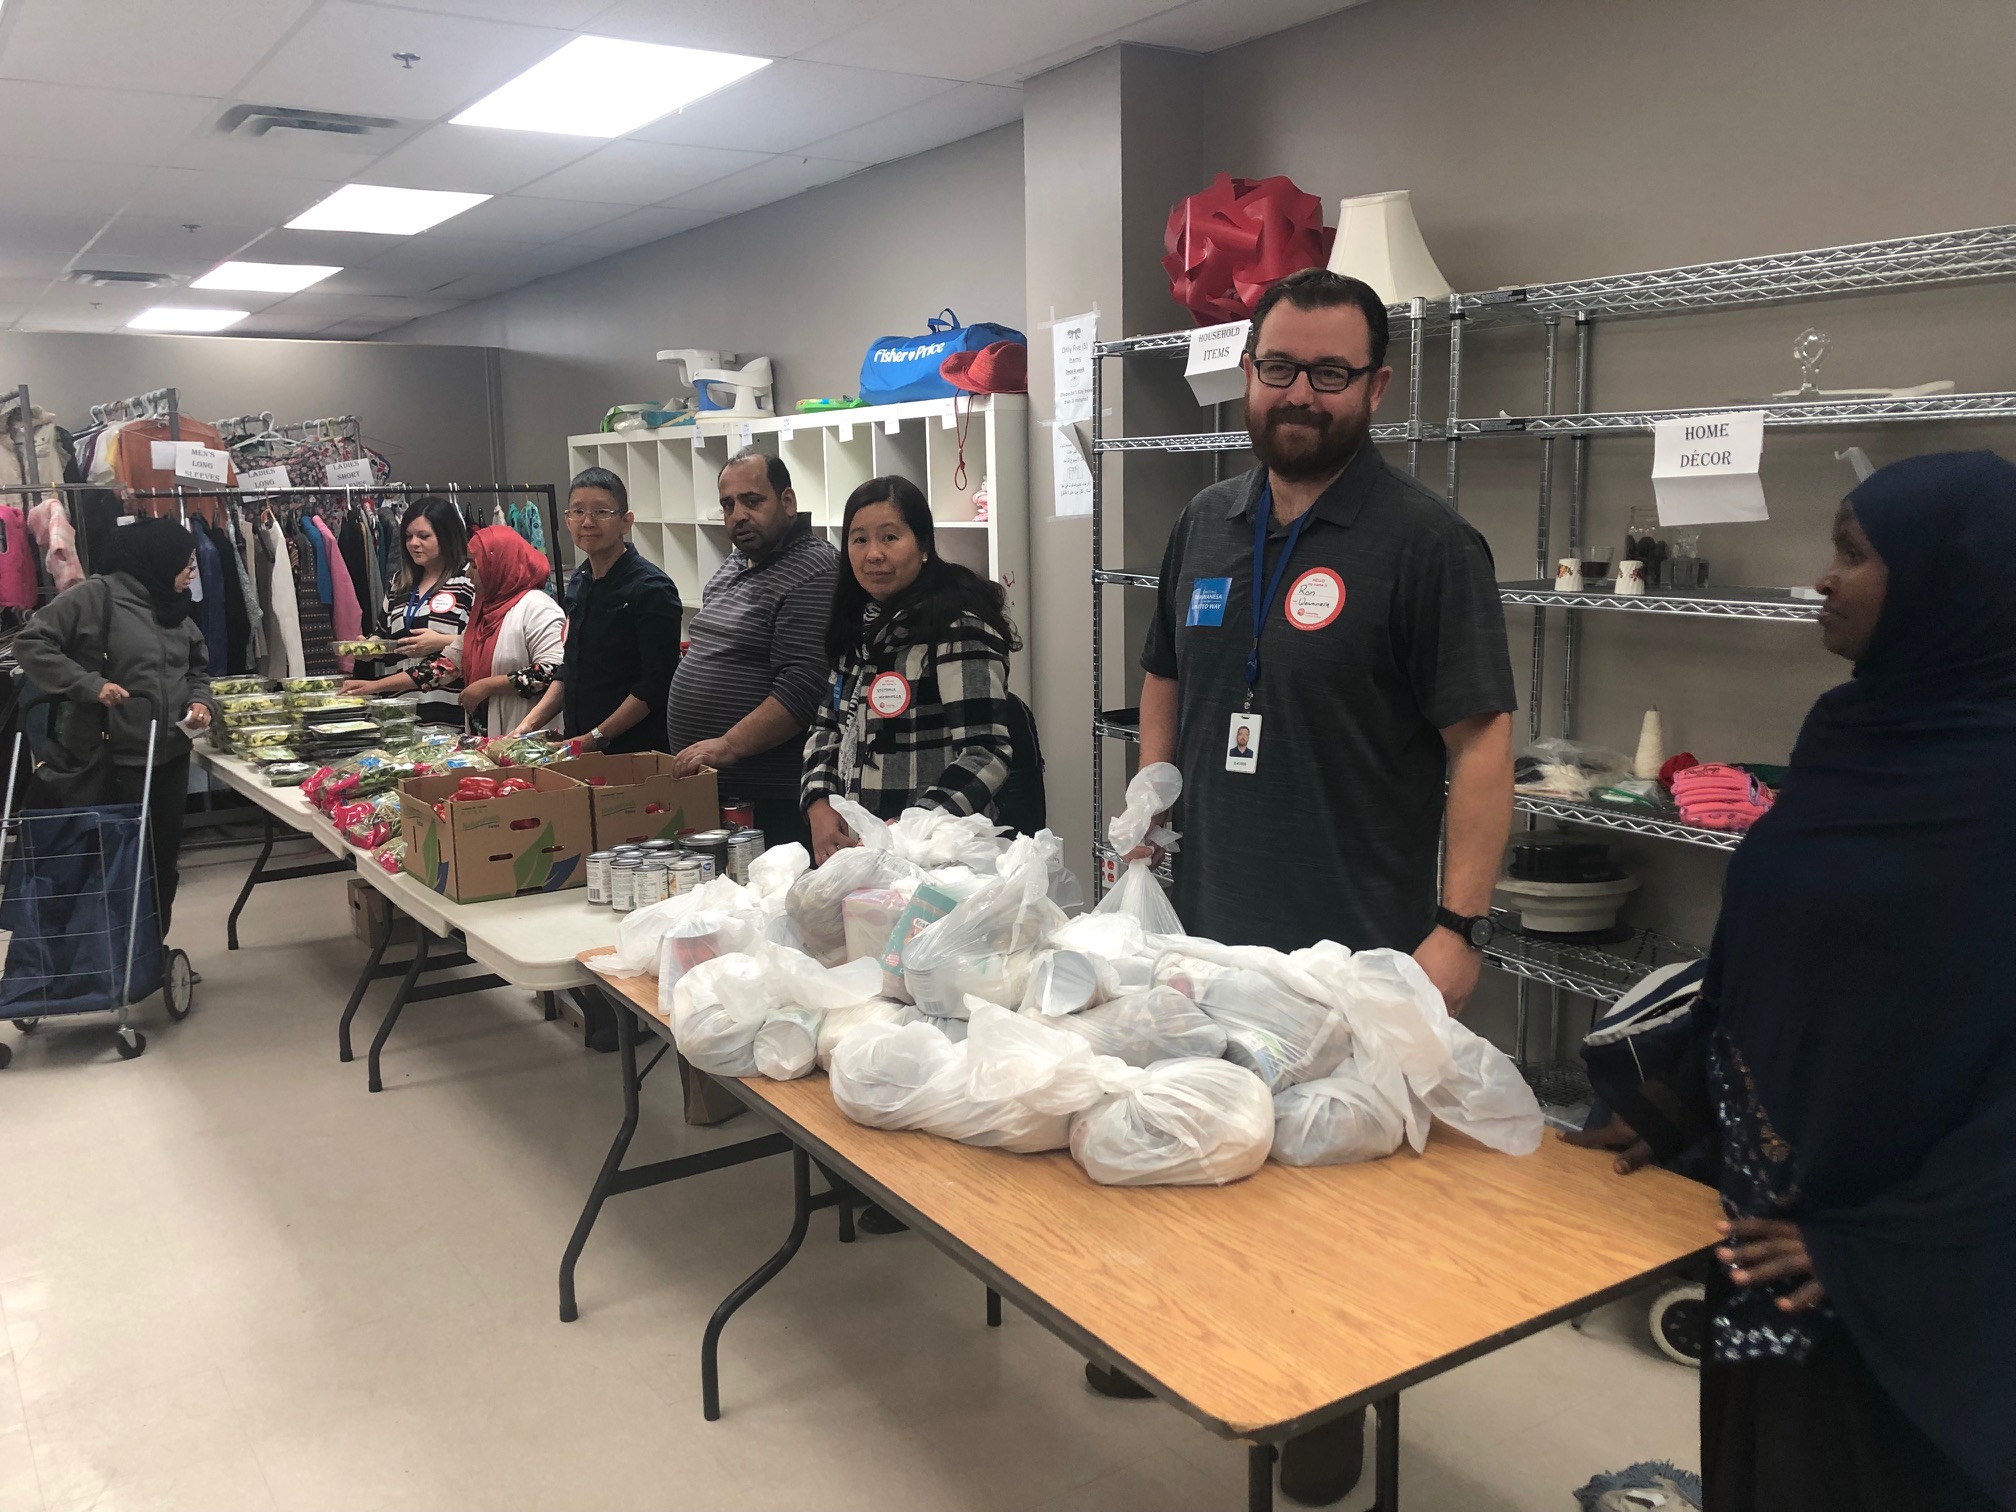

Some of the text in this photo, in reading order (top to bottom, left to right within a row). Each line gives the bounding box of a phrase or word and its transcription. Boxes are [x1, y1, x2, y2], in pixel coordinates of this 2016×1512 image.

[1199, 327, 1240, 342] HOUSEHOLD
[874, 342, 945, 362] Fisher Price
[1061, 346, 1073, 354] Only
[1203, 347, 1230, 360] ITEMS
[1685, 423, 1729, 440] HOME
[192, 449, 215, 458] MEN'S
[1680, 450, 1731, 467] DÉCOR
[192, 460, 213, 469] LONG
[333, 461, 360, 470] LADIES
[248, 469, 276, 478] LADIES
[337, 471, 360, 480] SHORT
[255, 479, 275, 488] LONG
[1299, 584, 1316, 596] Ron
